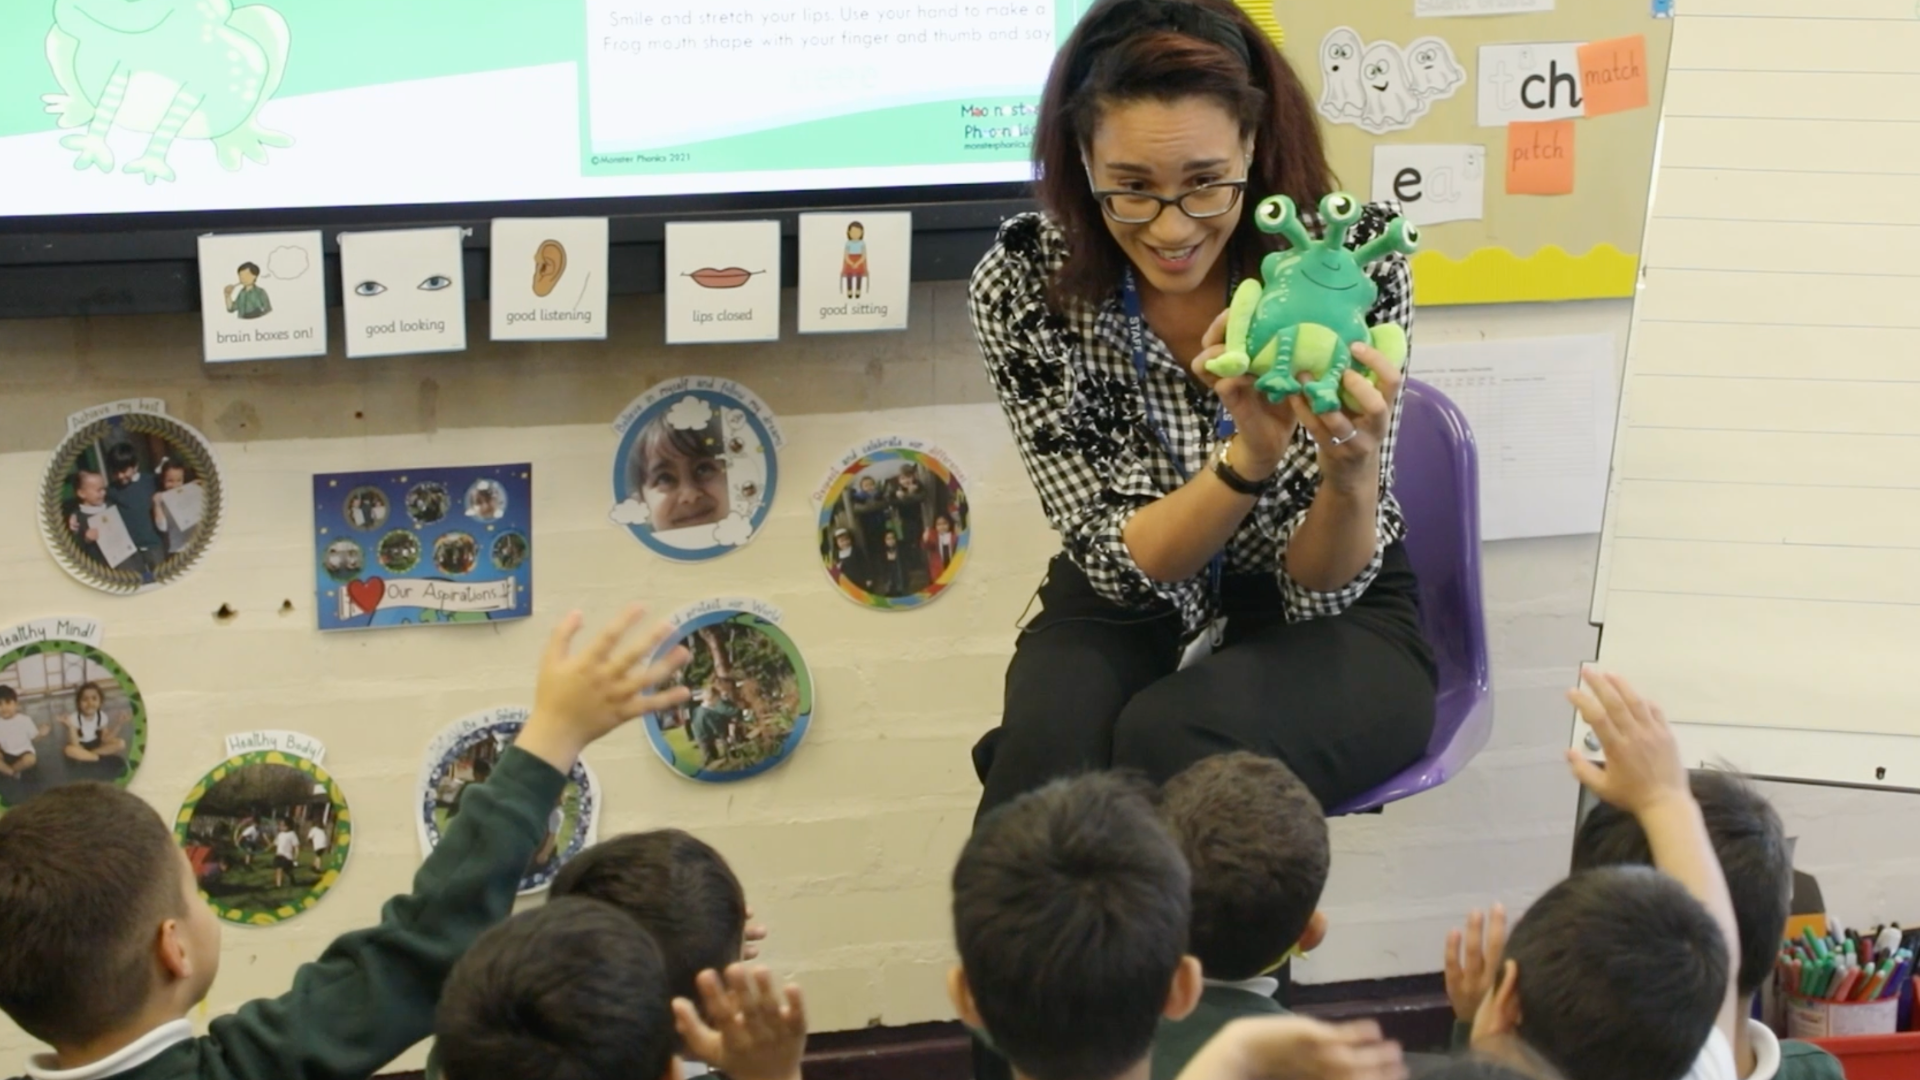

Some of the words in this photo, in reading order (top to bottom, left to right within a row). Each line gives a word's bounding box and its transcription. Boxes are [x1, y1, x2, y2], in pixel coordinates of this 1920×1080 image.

[609, 10, 654, 27] Smile
[661, 9, 692, 26] and
[698, 9, 754, 25] stretch
[761, 11, 796, 27] your
[803, 7, 835, 25] lips.
[839, 5, 869, 22] Use
[877, 8, 911, 23] your
[917, 4, 958, 19] hand
[964, 5, 981, 17] to
[986, 1, 1029, 17] make
[1035, 4, 1046, 16] a
[603, 36, 642, 55] Frog
[648, 34, 697, 50] mouth
[703, 33, 753, 51] shape
[762, 33, 794, 47] with
[800, 34, 836, 50] your
[841, 29, 889, 49] finger
[896, 28, 928, 44] and
[933, 27, 982, 42] thumb
[988, 26, 1019, 41] and
[1025, 26, 1052, 43] say
[1584, 52, 1641, 89] match
[637, 153, 667, 163] Phonics
[670, 153, 691, 162] 2021
[1511, 130, 1565, 173] pitch
[506, 308, 537, 324] good
[540, 306, 592, 325] listening
[692, 308, 714, 326] lips
[717, 308, 753, 322] closed
[819, 304, 847, 320] good
[851, 302, 888, 319] sitting
[216, 328, 251, 344] brain
[255, 327, 290, 342] boxes
[293, 325, 315, 340] on!
[365, 320, 396, 339] good
[400, 318, 446, 337] looking
[1128, 316, 1143, 353] STAFF
[71, 405, 110, 428] Achieve
[117, 402, 132, 413] my
[615, 404, 643, 433] Believe
[696, 377, 715, 389] and
[842, 448, 857, 466] and
[862, 436, 903, 453] celebrate
[387, 583, 414, 600] Our
[751, 599, 783, 622] World
[56, 619, 97, 638] Mind!
[228, 732, 278, 751] Healthy
[286, 733, 324, 759] Body!
